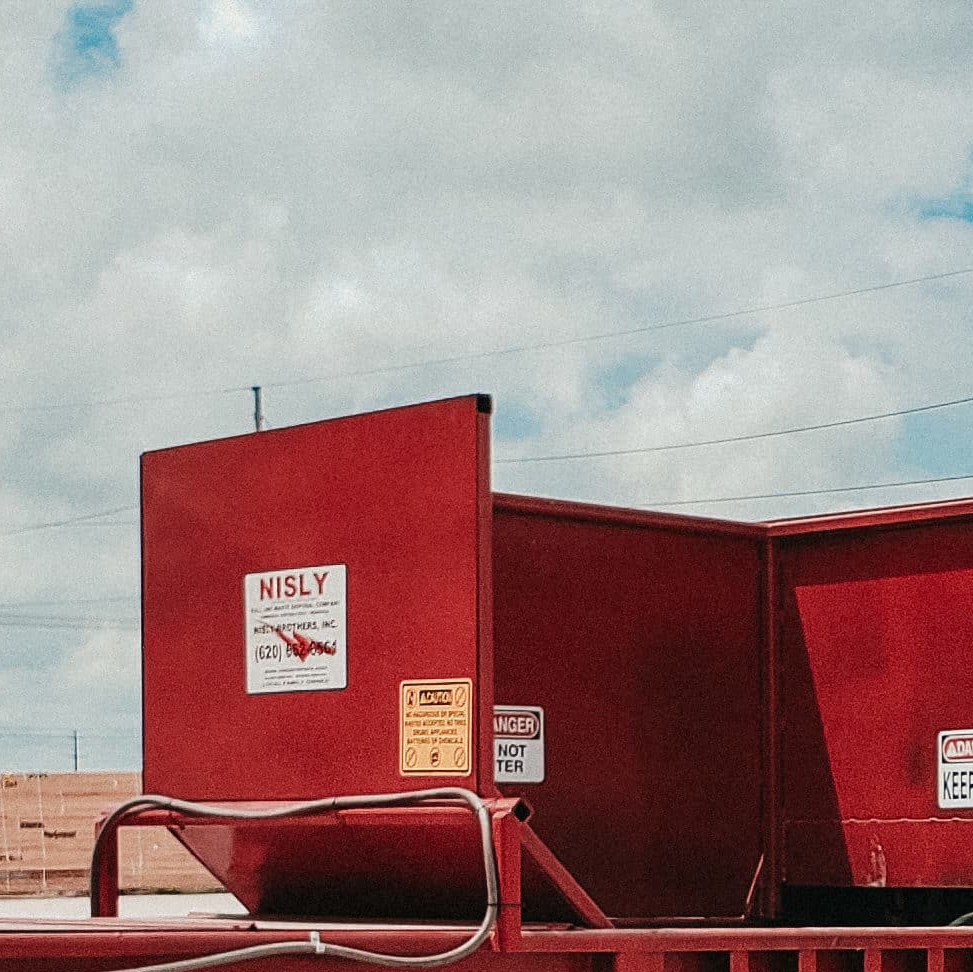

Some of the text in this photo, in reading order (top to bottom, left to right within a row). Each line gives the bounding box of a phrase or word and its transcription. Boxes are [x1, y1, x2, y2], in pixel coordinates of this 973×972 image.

[260, 571, 329, 600] NISLY
[255, 643, 282, 664] (620)
[498, 743, 527, 758] NOT
[956, 740, 973, 757] DA
[496, 759, 524, 773] TER
